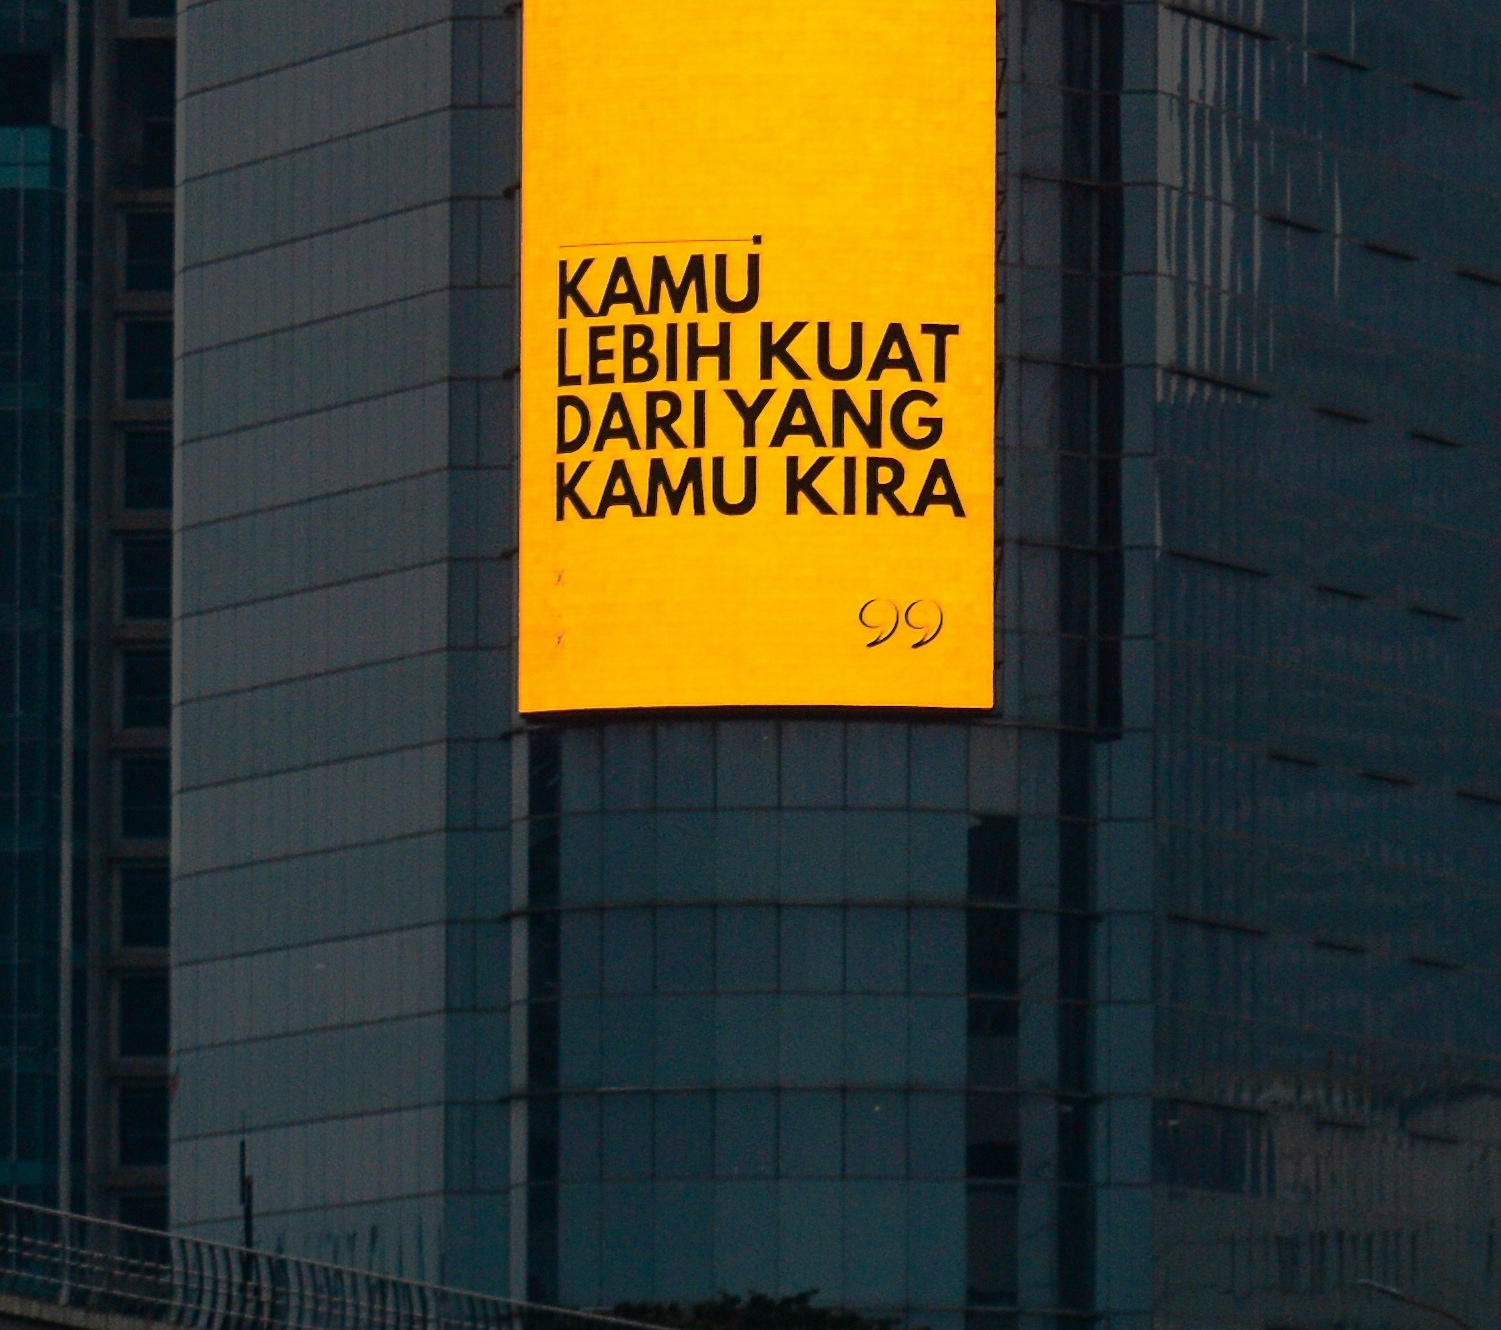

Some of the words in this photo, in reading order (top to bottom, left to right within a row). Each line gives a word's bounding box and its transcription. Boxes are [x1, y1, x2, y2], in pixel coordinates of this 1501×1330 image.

[558, 252, 760, 319] KAMU
[557, 321, 731, 387] LEBIH
[759, 321, 960, 382] KUAT
[556, 389, 706, 454] DARI
[723, 389, 943, 451] YANG
[555, 456, 757, 522] KAMU
[784, 455, 967, 518] KIRA
